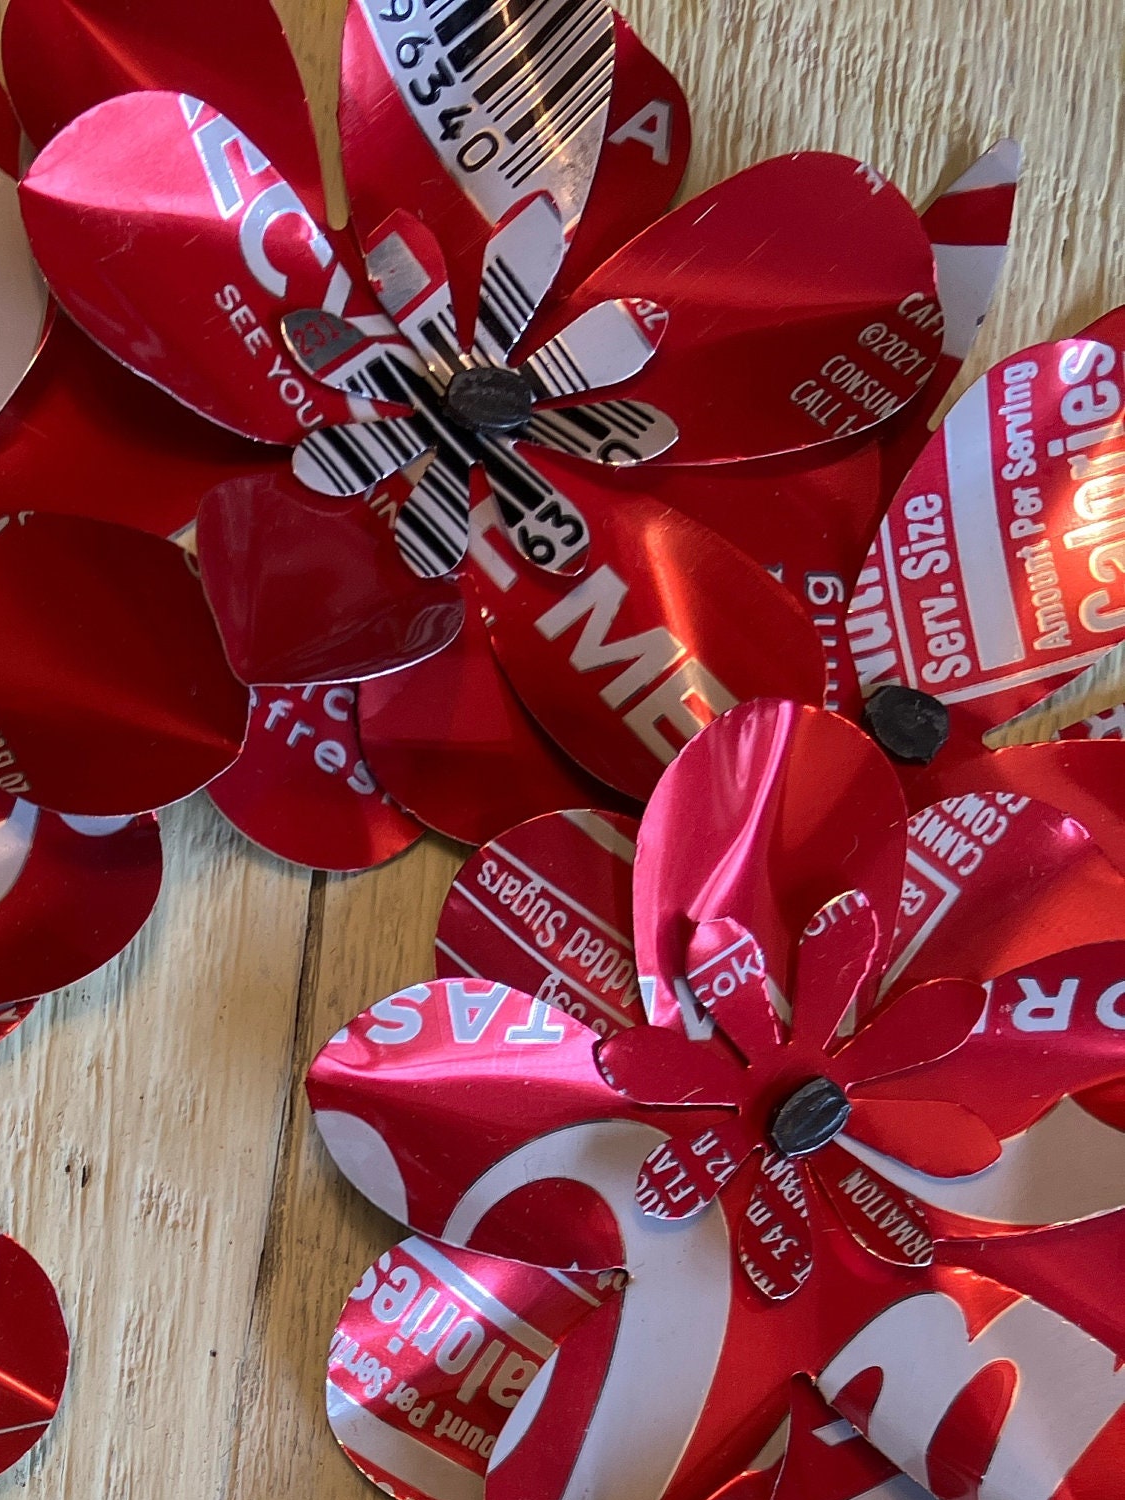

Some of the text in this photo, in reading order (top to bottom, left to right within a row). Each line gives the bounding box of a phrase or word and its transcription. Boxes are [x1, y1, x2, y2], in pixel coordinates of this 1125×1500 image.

[214, 283, 273, 357] SEE
[267, 354, 324, 428] YOU
[790, 380, 833, 427] CALL
[901, 493, 950, 580] Size
[1000, 361, 1072, 650] Amount Per Serving
[476, 859, 568, 949] Sugars
[385, 1380, 436, 1430] Per
